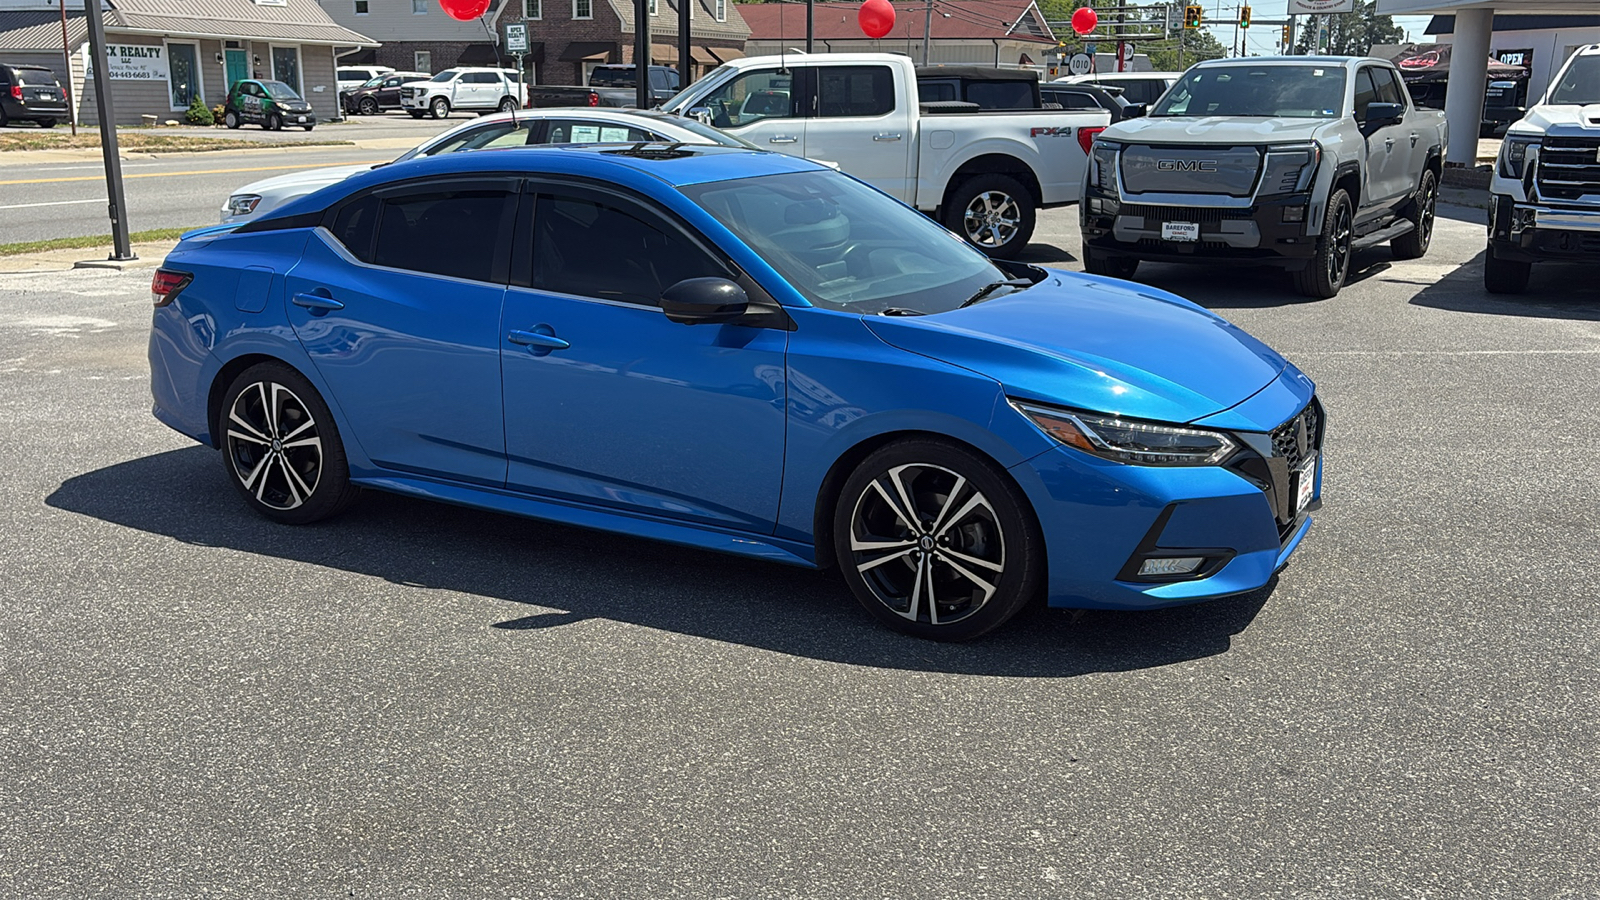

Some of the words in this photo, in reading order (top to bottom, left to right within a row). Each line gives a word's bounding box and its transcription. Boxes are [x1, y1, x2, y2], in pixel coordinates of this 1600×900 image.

[120, 46, 161, 58] REALTY
[1072, 60, 1088, 69] 1010
[1501, 53, 1524, 65] OPEN
[108, 71, 151, 79] 04-443-6683
[1030, 127, 1072, 138] FX4
[1157, 159, 1218, 172] GMC
[1165, 224, 1196, 232] BAREFORD
